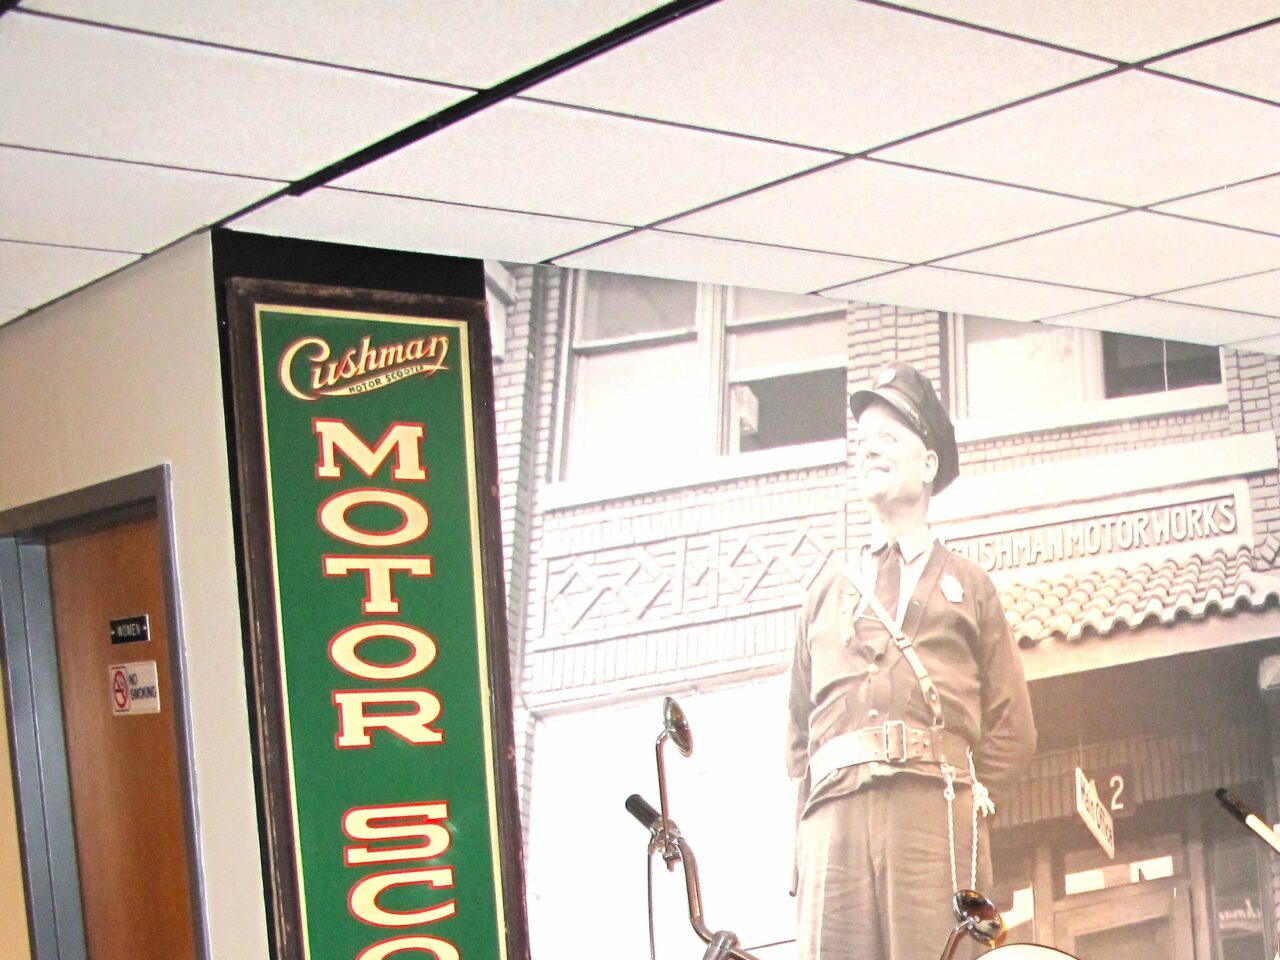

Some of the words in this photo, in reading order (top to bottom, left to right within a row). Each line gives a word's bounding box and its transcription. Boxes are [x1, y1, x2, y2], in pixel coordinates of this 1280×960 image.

[279, 336, 450, 401] Cushman
[348, 378, 383, 394] MOTOR
[385, 365, 425, 383] SCOOTER
[1064, 513, 1151, 557] MOTOR
[1153, 500, 1238, 545] WORKS
[312, 417, 446, 750] MOTOR
[118, 623, 141, 637] WOMEN
[129, 673, 138, 685] NO
[130, 685, 157, 700] SMOKING
[1110, 775, 1124, 811] 2
